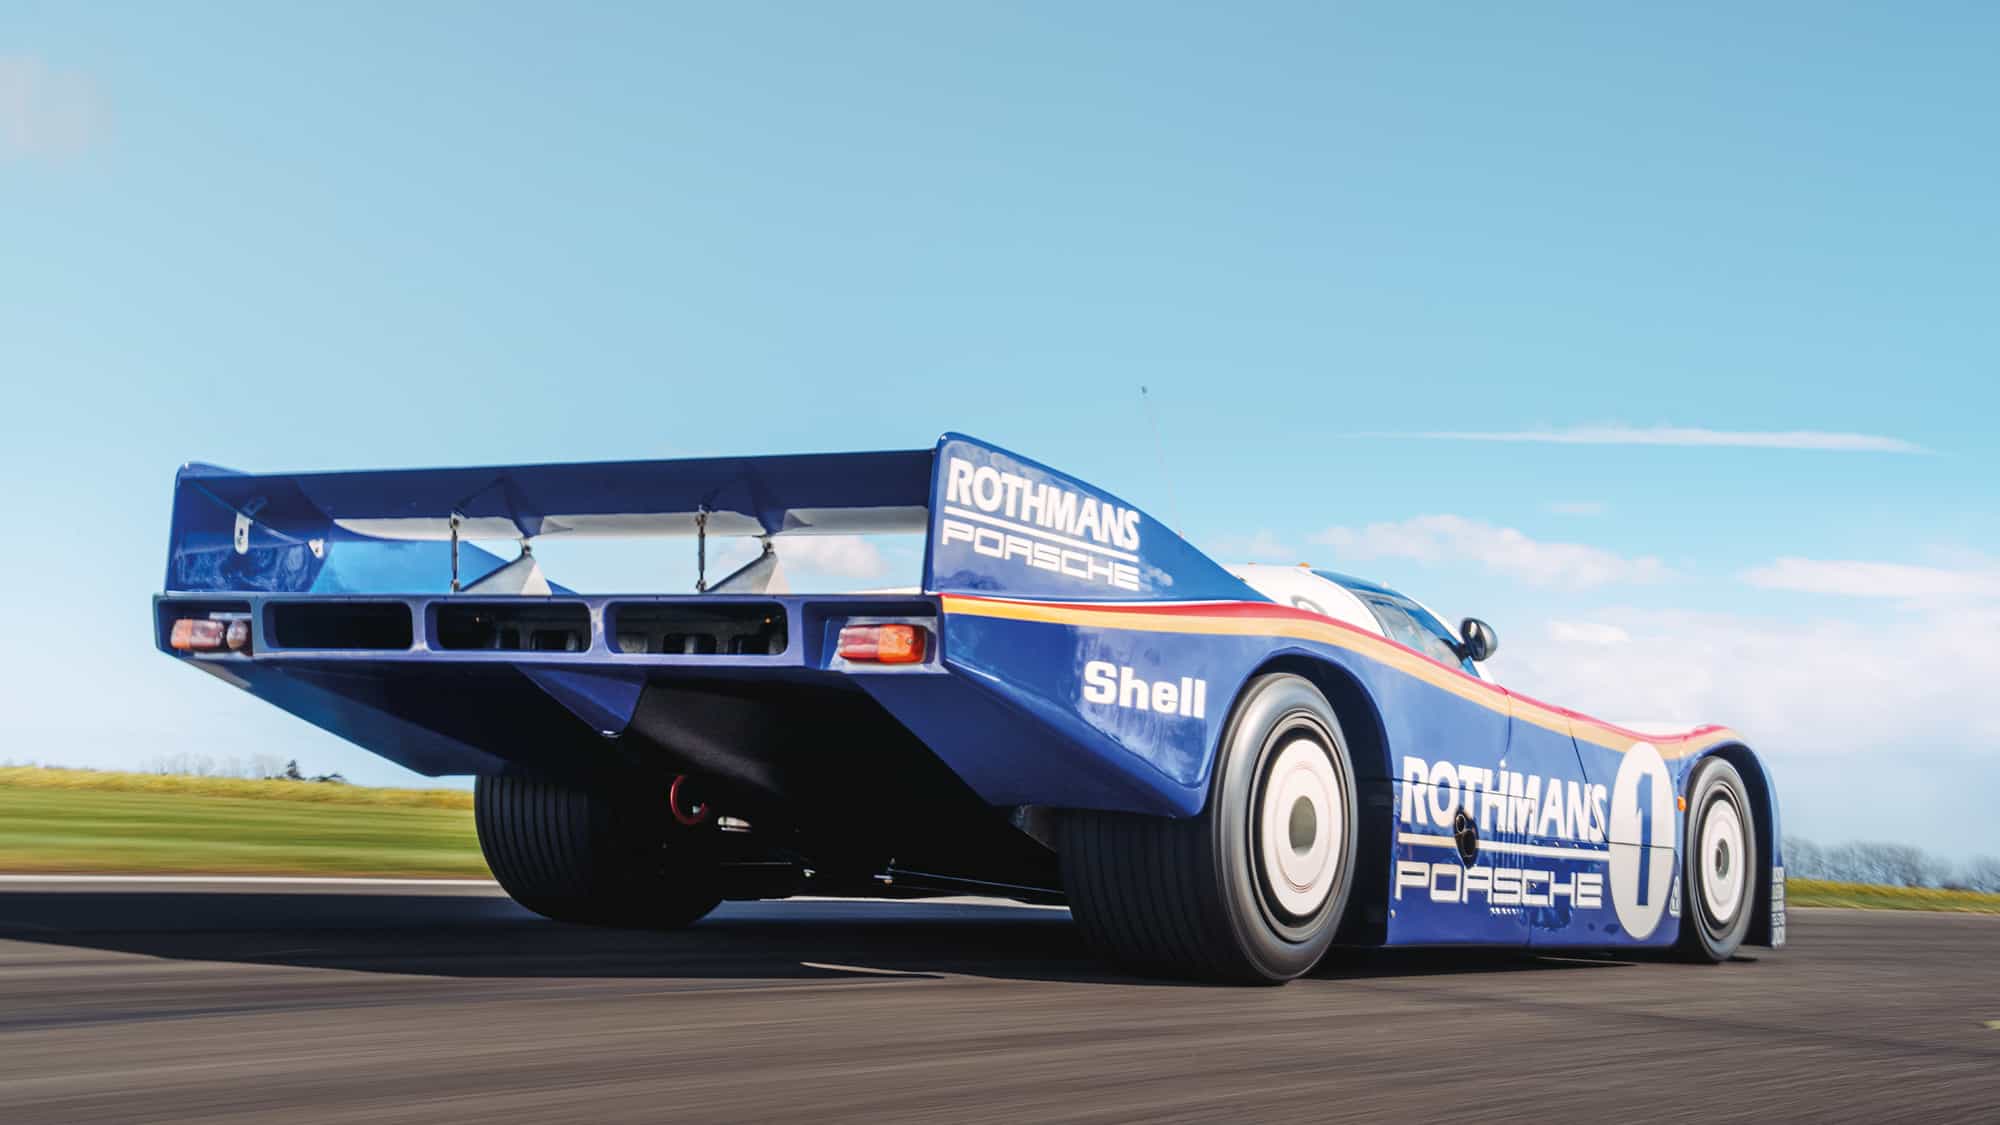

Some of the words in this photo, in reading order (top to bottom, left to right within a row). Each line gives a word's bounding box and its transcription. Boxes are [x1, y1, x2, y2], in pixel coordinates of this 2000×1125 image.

[946, 457, 1140, 551] ROTHMANS
[942, 519, 1140, 590] PORSCHE
[1083, 661, 1206, 718] Shell
[1401, 756, 1607, 841] ROTHMANS
[1634, 773, 1652, 906] 1
[1395, 860, 1603, 908] PORSCHE
